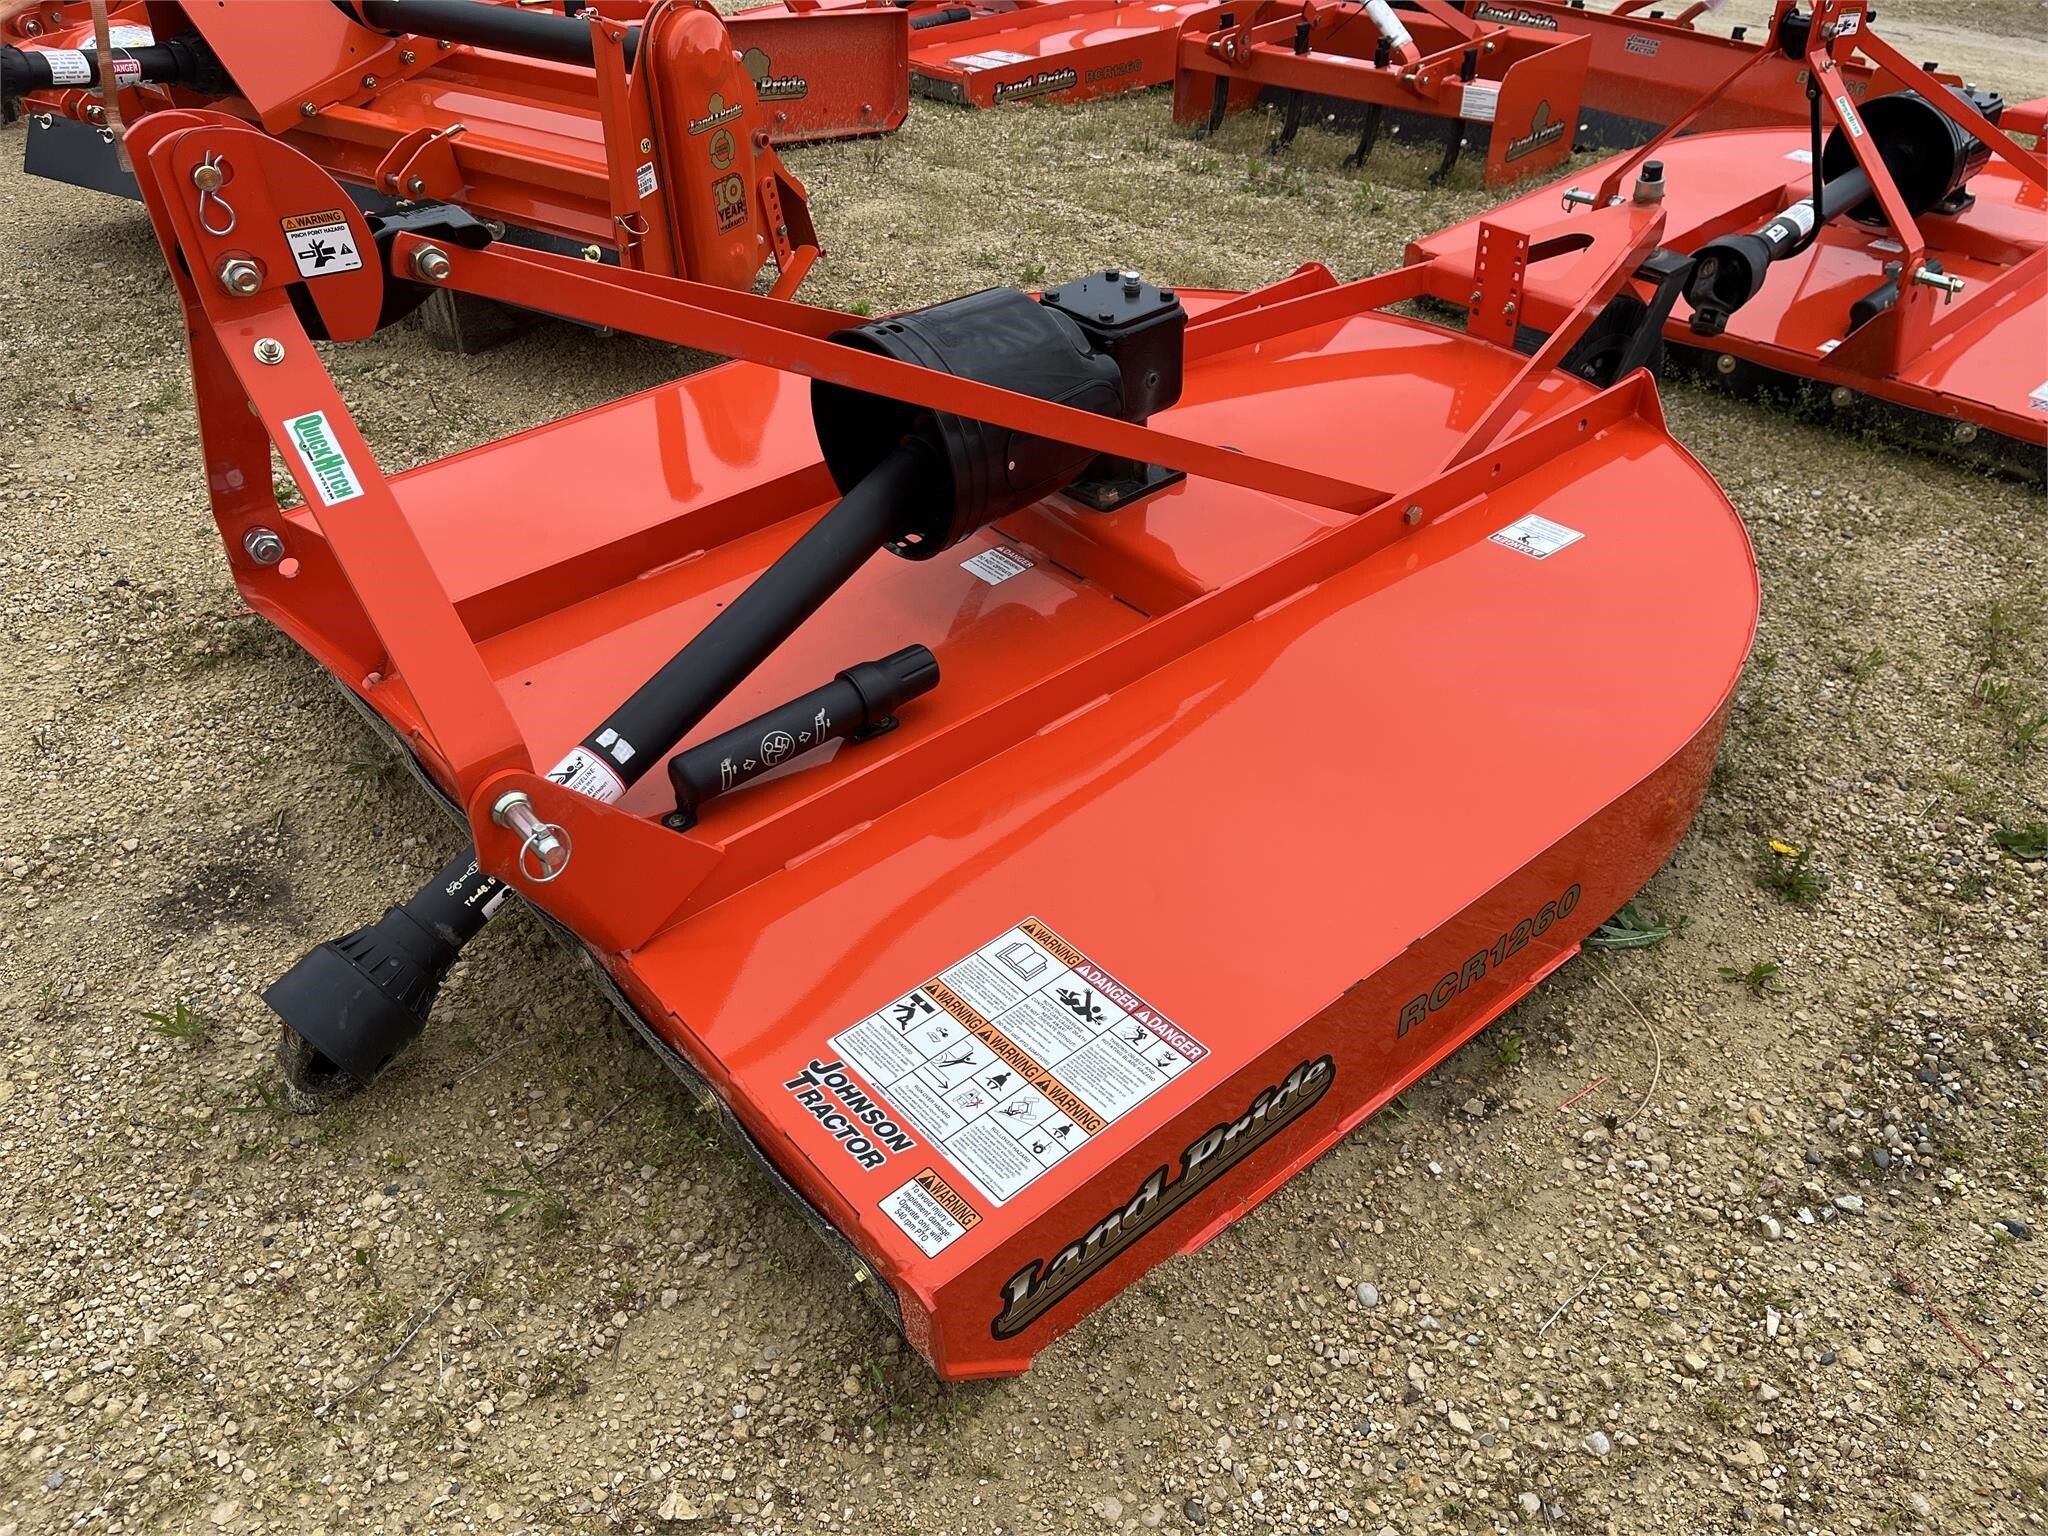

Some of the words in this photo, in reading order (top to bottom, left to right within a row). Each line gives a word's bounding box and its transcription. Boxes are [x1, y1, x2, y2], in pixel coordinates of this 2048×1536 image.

[1478, 2, 1513, 18] Land
[1518, 11, 1557, 29] Pride
[760, 75, 806, 93] Pride
[995, 76, 1032, 95] Land
[1038, 68, 1075, 85] Pride
[688, 114, 714, 130] Land
[720, 103, 743, 118] Pride
[715, 177, 742, 211] 10
[718, 201, 745, 222] YEAR
[290, 231, 307, 239] PINCH
[323, 225, 345, 233] HAZARD
[295, 211, 341, 227] WARNING
[1003, 548, 1034, 568] DANGER
[1492, 534, 1531, 553] DANGER
[572, 767, 596, 791] RIVELINE
[1031, 928, 1081, 965] WARNING
[1397, 884, 1582, 1040] RCR1260
[933, 989, 983, 1029] WARNING
[1042, 999, 1063, 1016] ROTATING
[1086, 971, 1139, 1011] DANGER
[1002, 1025, 1012, 1033] NOT
[1018, 1039, 1029, 1047] PTO
[1029, 1008, 1039, 1016] NOT
[1037, 1015, 1057, 1031] OPERATE
[1030, 997, 1050, 1012] CONTACT
[1058, 1018, 1073, 1030] CAUSE
[1071, 1029, 1087, 1042] DEATH
[897, 1041, 913, 1054] HAZARD
[1109, 1038, 1128, 1053] THROWN
[1127, 1052, 1145, 1067] OBJECT
[1144, 1066, 1155, 1074] AND
[1146, 1017, 1203, 1059] DANGER
[987, 1035, 1040, 1078] WARNING
[1100, 1038, 1123, 1056] ROTATING
[1121, 1055, 1137, 1067] BLADE
[1136, 1066, 1155, 1081] HAZARD
[784, 1069, 886, 1169] TRACTOR
[808, 1059, 916, 1153] JOHNSON
[913, 1084, 924, 1093] RUN
[921, 1092, 934, 1103] OVER
[932, 1102, 951, 1118] HAZARD
[1046, 1085, 1102, 1132] WARNING
[990, 1126, 1014, 1147] ROLLOVER
[1012, 1146, 1031, 1163] HAZARD
[931, 1181, 976, 1226] WARNING
[1004, 1165, 1168, 1318] Land
[1182, 1056, 1330, 1190] Pride
[898, 1199, 920, 1220] Operate
[917, 1219, 931, 1232] only
[929, 1230, 943, 1243] with
[902, 1190, 930, 1217] implement
[928, 1215, 952, 1239] damage:
[911, 1184, 920, 1193] To
[917, 1191, 933, 1207] avoid
[931, 1205, 948, 1221] injury
[946, 1220, 955, 1228] or
[894, 1209, 907, 1220] 540
[903, 1219, 916, 1231] rpm
[914, 1228, 929, 1241] PTO
